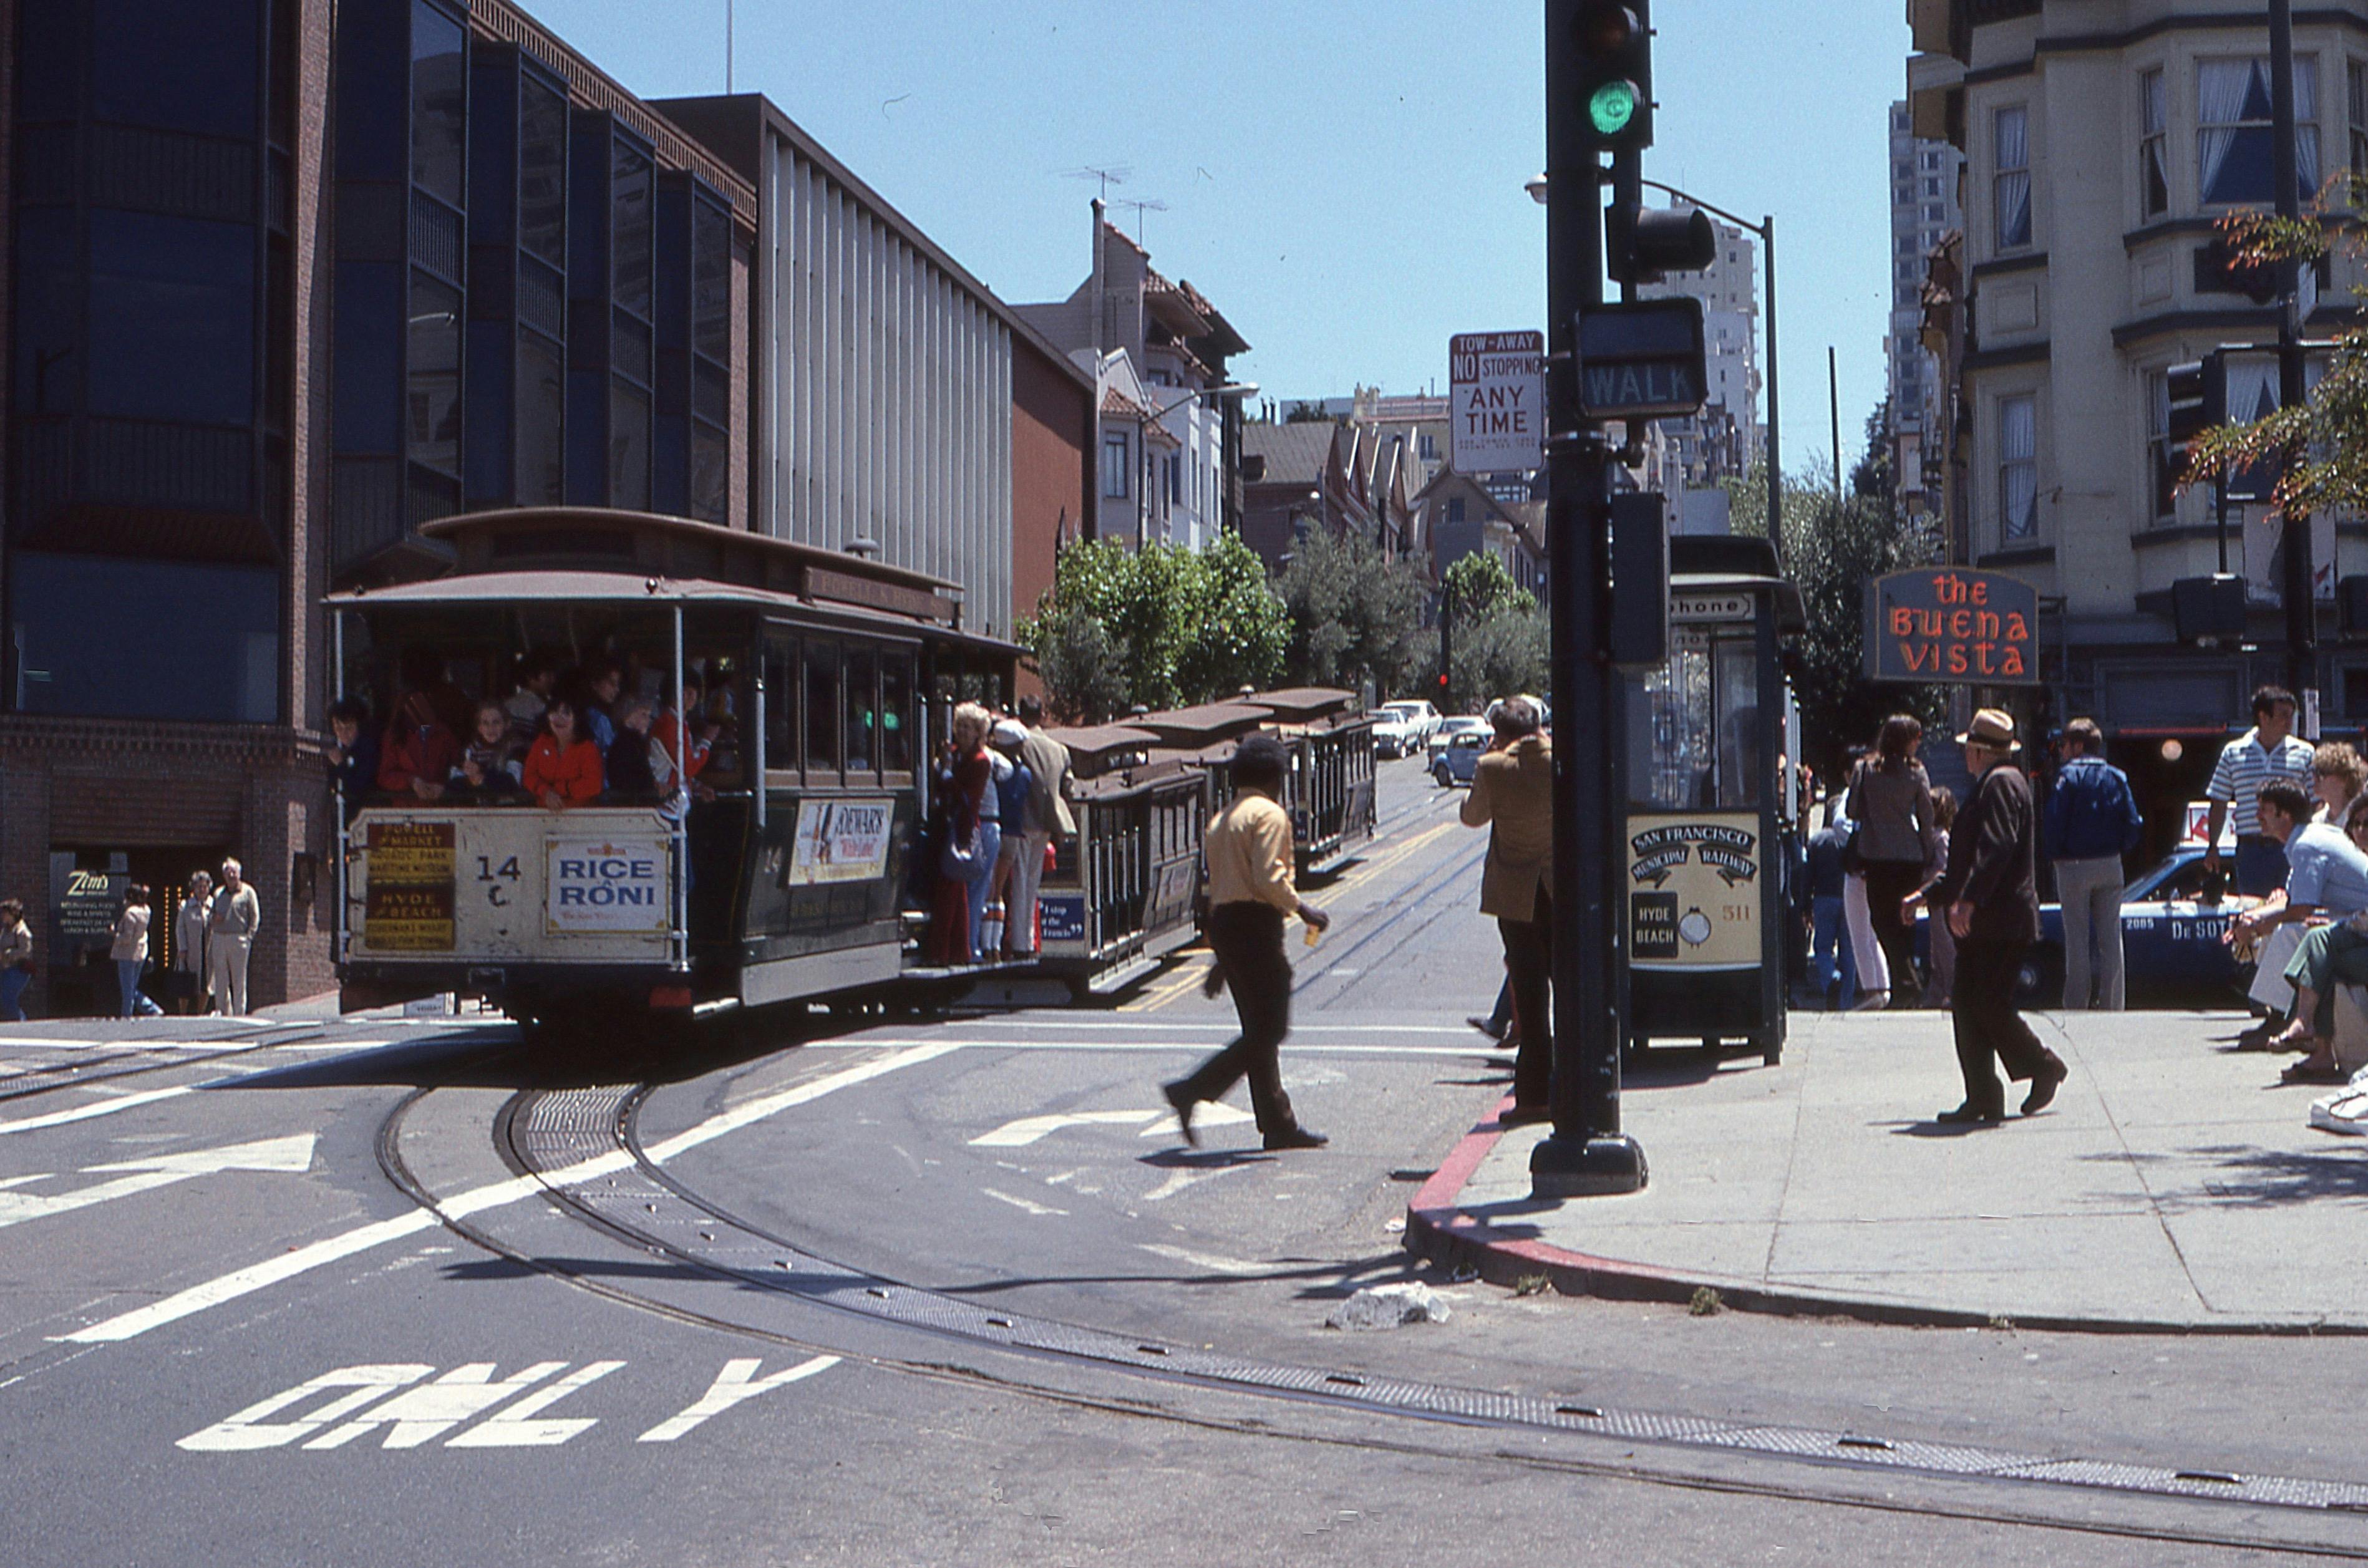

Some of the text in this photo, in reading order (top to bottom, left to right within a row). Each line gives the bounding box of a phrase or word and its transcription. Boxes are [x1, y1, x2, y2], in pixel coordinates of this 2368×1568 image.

[1458, 333, 1535, 352] TOW-AWAY
[1453, 353, 1540, 380] NO STOPPING
[1588, 364, 1689, 405] WALK
[1469, 385, 1524, 409] ANY
[1466, 411, 1528, 435] TIME
[1933, 573, 1988, 606] the
[1634, 826, 1750, 849] SAN FRANCISCO
[478, 856, 521, 881] 14
[560, 859, 654, 879] RICE
[1633, 850, 1755, 879] MUNICIPAL RAILWAY
[560, 886, 656, 906] RONI
[1639, 906, 1671, 922] HYDE
[1722, 905, 1750, 921] 511
[1636, 929, 1674, 944] BEACH
[175, 1355, 841, 1450] ONLY
